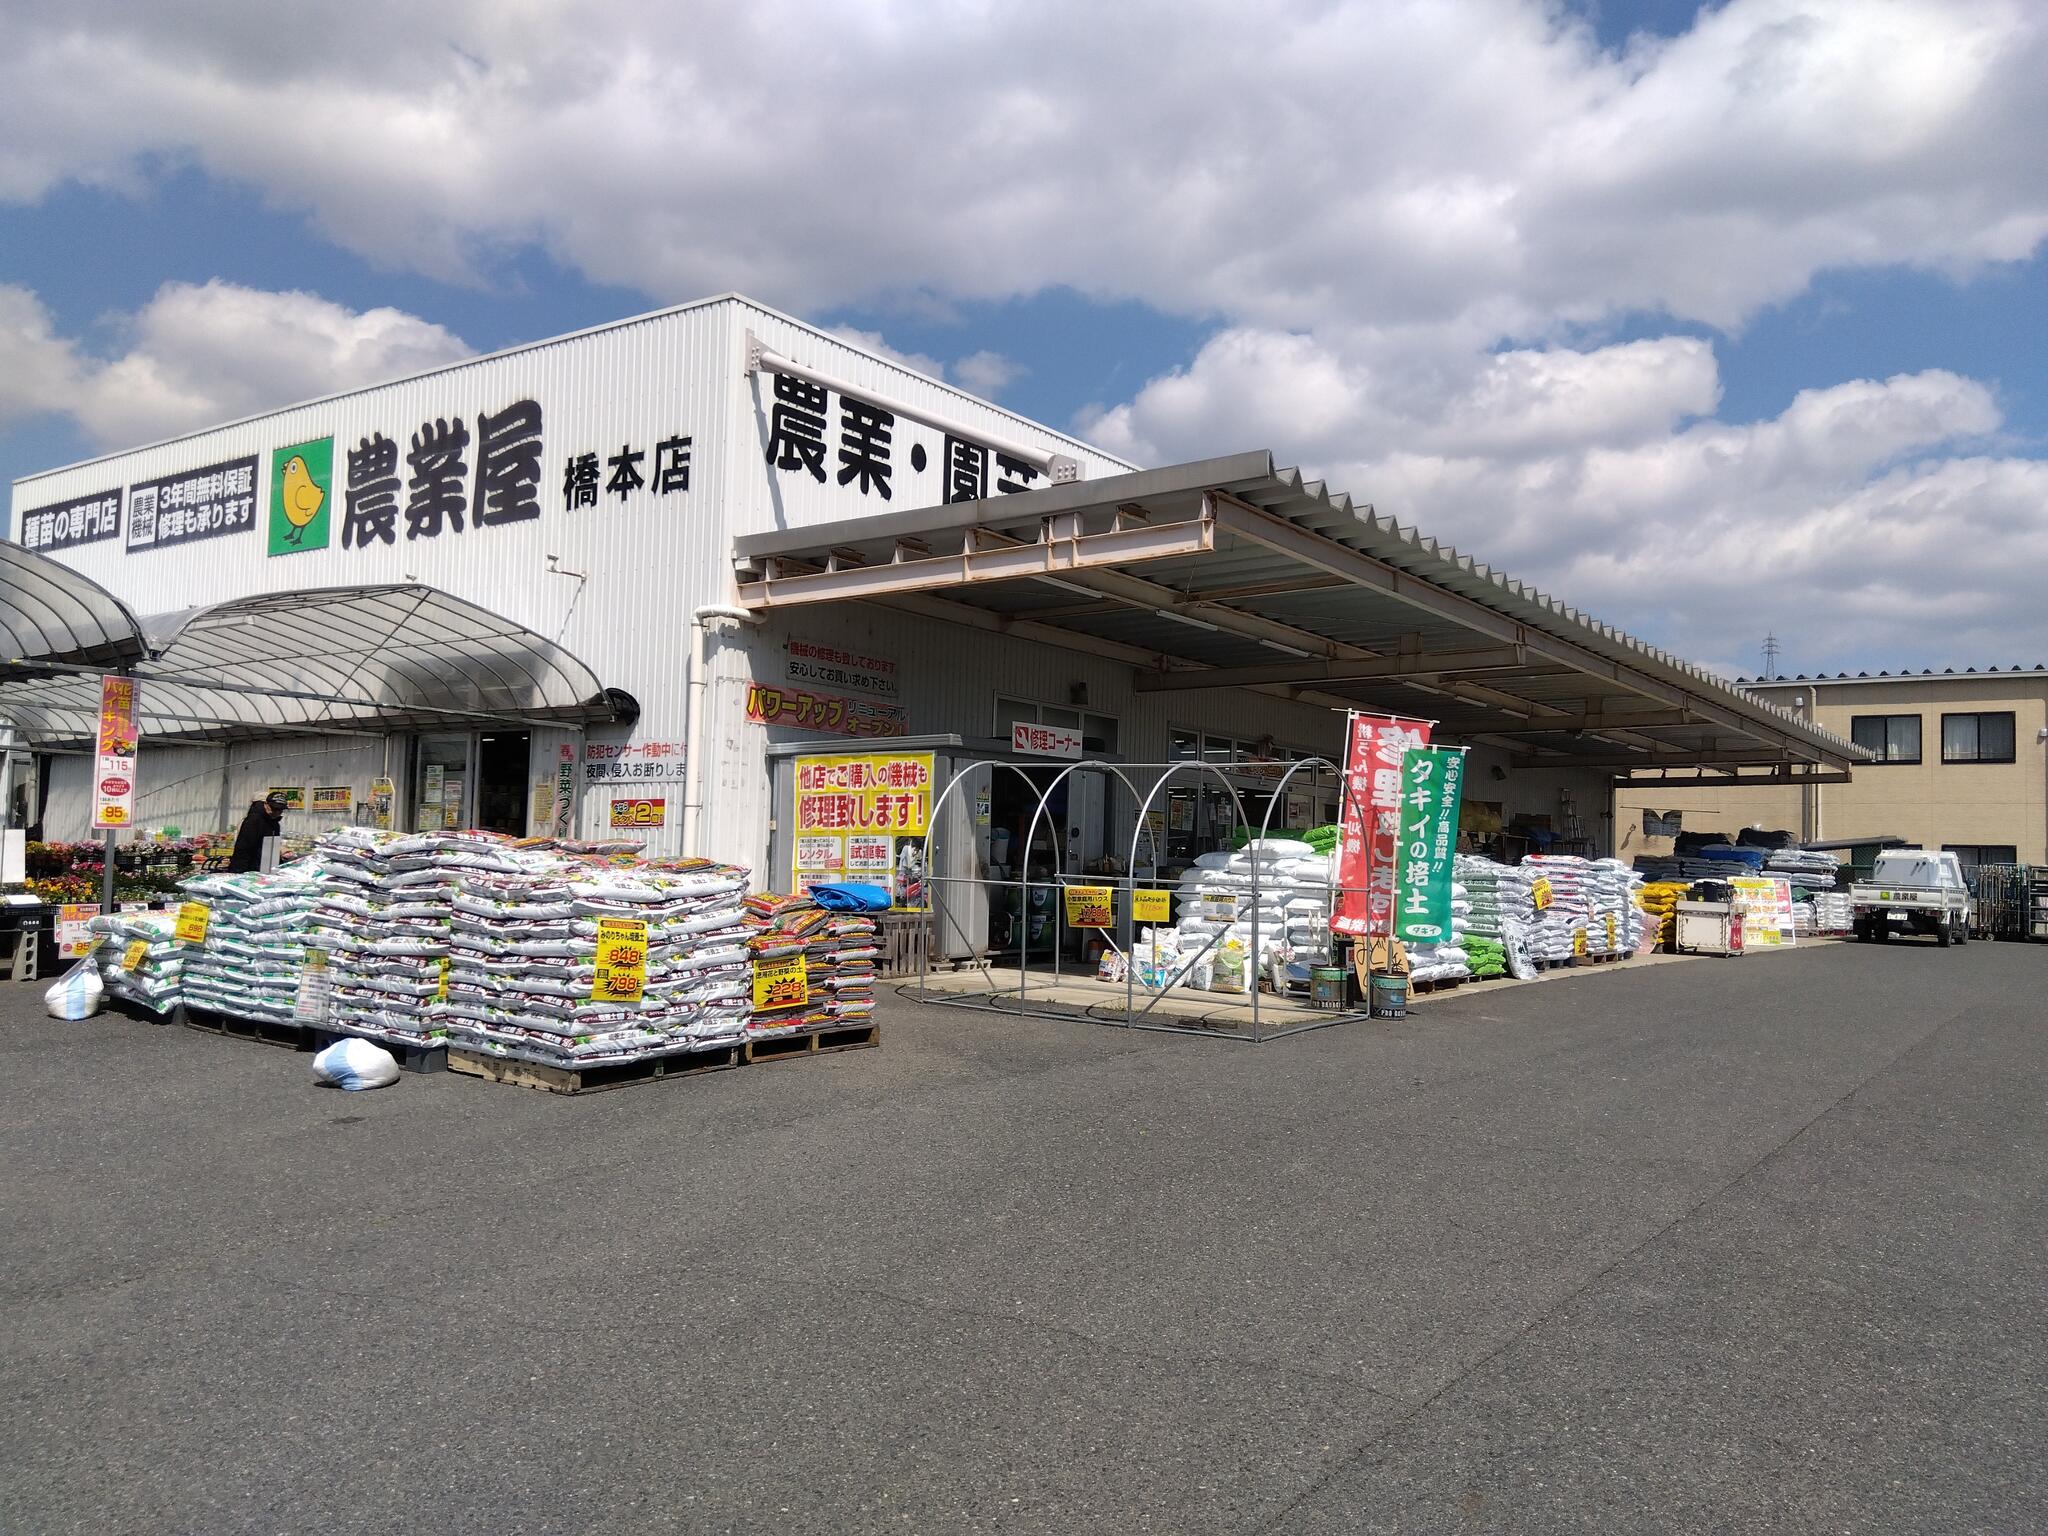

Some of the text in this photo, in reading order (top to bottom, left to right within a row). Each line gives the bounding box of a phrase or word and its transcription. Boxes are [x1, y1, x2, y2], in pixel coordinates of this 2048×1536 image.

[160, 466, 252, 508] 3年間無料保証
[341, 399, 543, 550] 農業屋
[562, 435, 693, 511] 橋本店
[24, 498, 117, 548] 種苗の専門店
[158, 496, 253, 540] 修理も承ります
[746, 687, 844, 728] パワーアップ
[1030, 729, 1081, 752] 修理コーナー
[799, 762, 928, 790] 他店でご購入の機械も
[799, 793, 924, 829] 修理致します!
[800, 849, 833, 860] レンタル
[850, 845, 886, 859] 試運転
[1404, 759, 1434, 915] タキイの培土
[610, 949, 639, 963] 848
[608, 977, 637, 991] 798
[771, 981, 802, 996] 228
